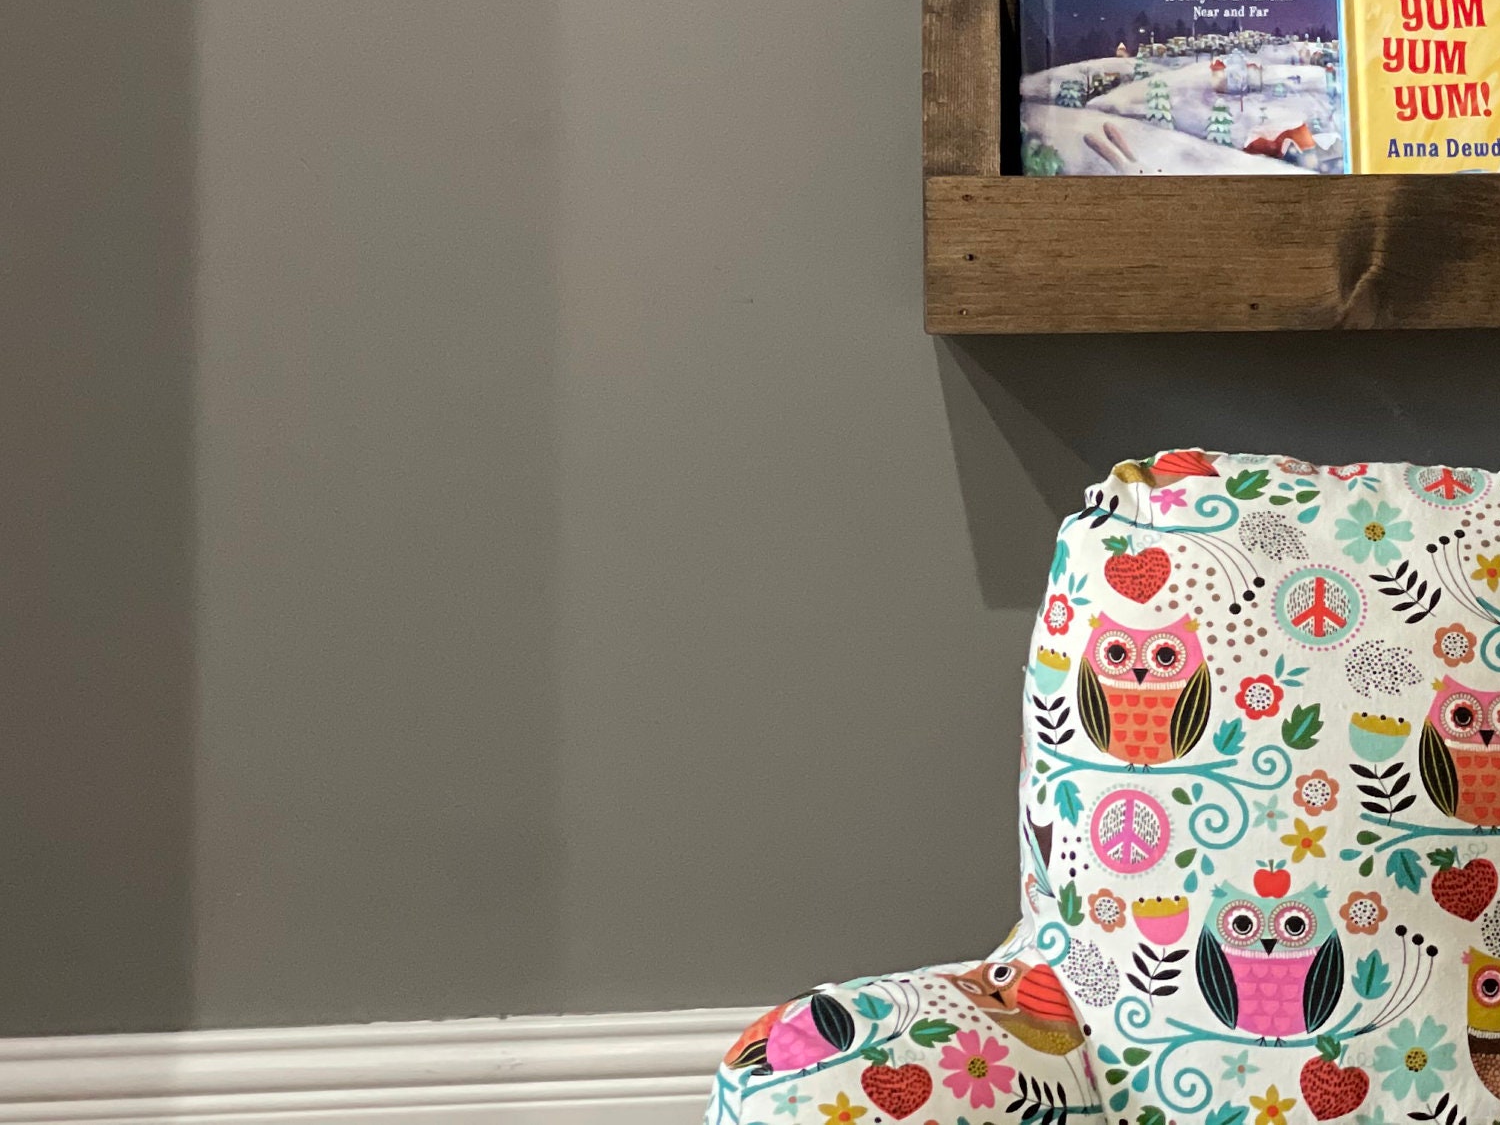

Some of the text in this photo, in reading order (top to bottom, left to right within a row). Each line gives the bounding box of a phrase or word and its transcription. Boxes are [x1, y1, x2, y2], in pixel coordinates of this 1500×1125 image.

[1193, 5, 1269, 20] Near and Far
[1382, 37, 1467, 75] YUM
[1393, 81, 1492, 122] YUM!
[1387, 138, 1439, 159] Anna
